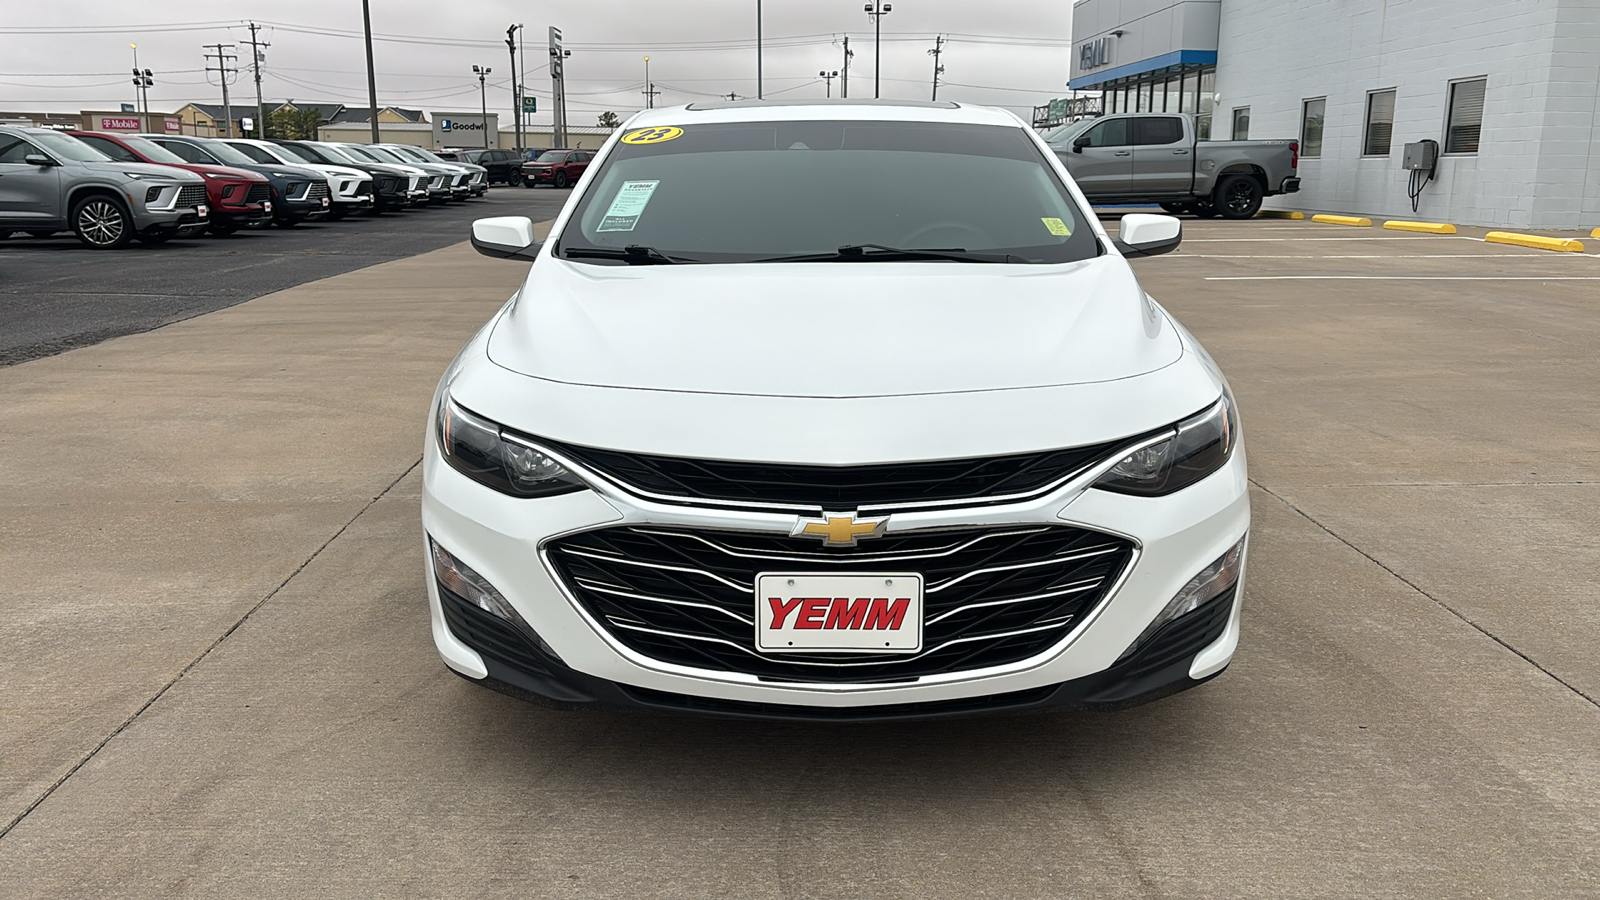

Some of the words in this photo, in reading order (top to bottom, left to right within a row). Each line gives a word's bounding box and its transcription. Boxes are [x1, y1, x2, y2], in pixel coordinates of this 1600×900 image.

[111, 120, 138, 129] Mobile
[452, 122, 488, 131] Goodwi
[630, 128, 671, 142] 23
[768, 597, 911, 631] YEMM
